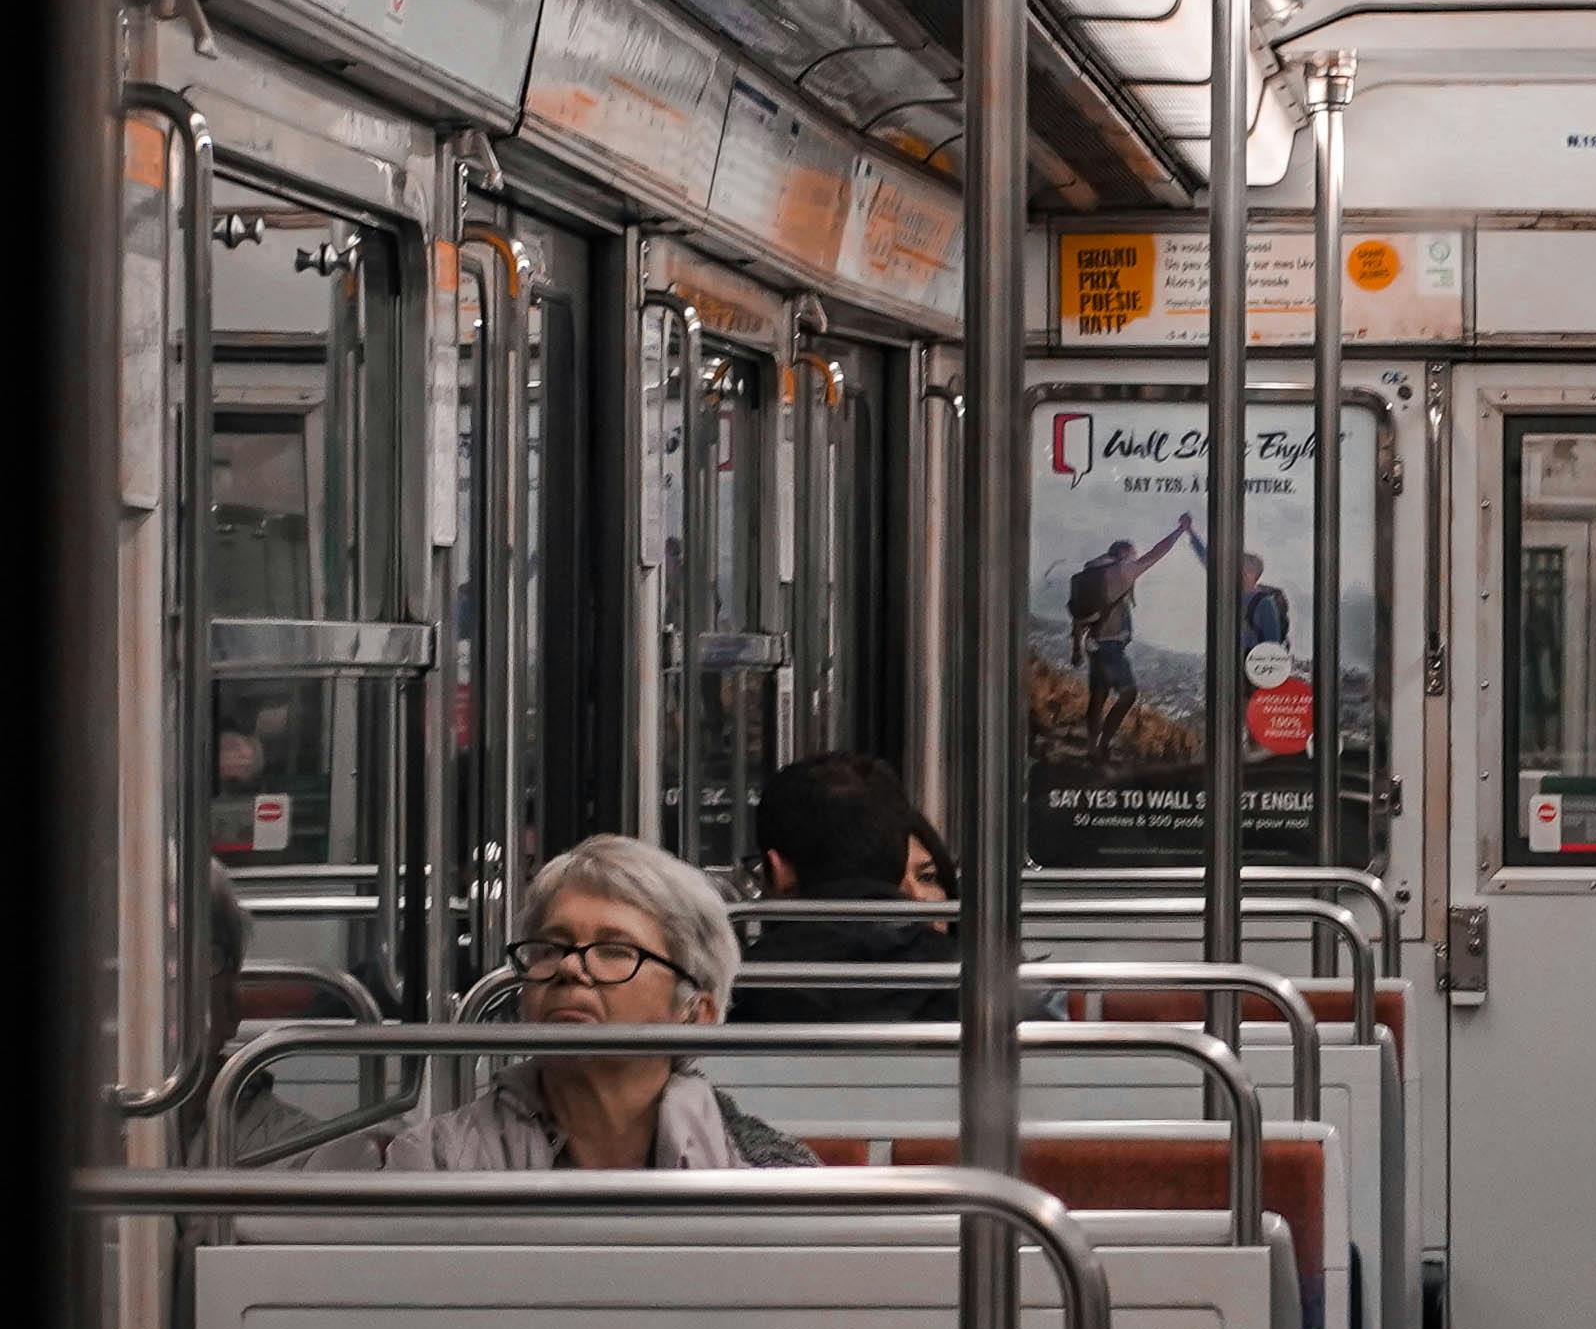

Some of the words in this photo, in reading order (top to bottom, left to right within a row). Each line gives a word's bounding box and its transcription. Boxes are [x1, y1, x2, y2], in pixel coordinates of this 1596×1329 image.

[1077, 247, 1138, 269] GRAND
[1078, 271, 1121, 292] PRIX
[1078, 315, 1129, 337] RATP
[1102, 429, 1170, 460] Wall
[1049, 789, 1080, 809] SAY
[1084, 790, 1118, 809] YES
[1120, 790, 1142, 810] TO
[1147, 790, 1193, 810] WALL
